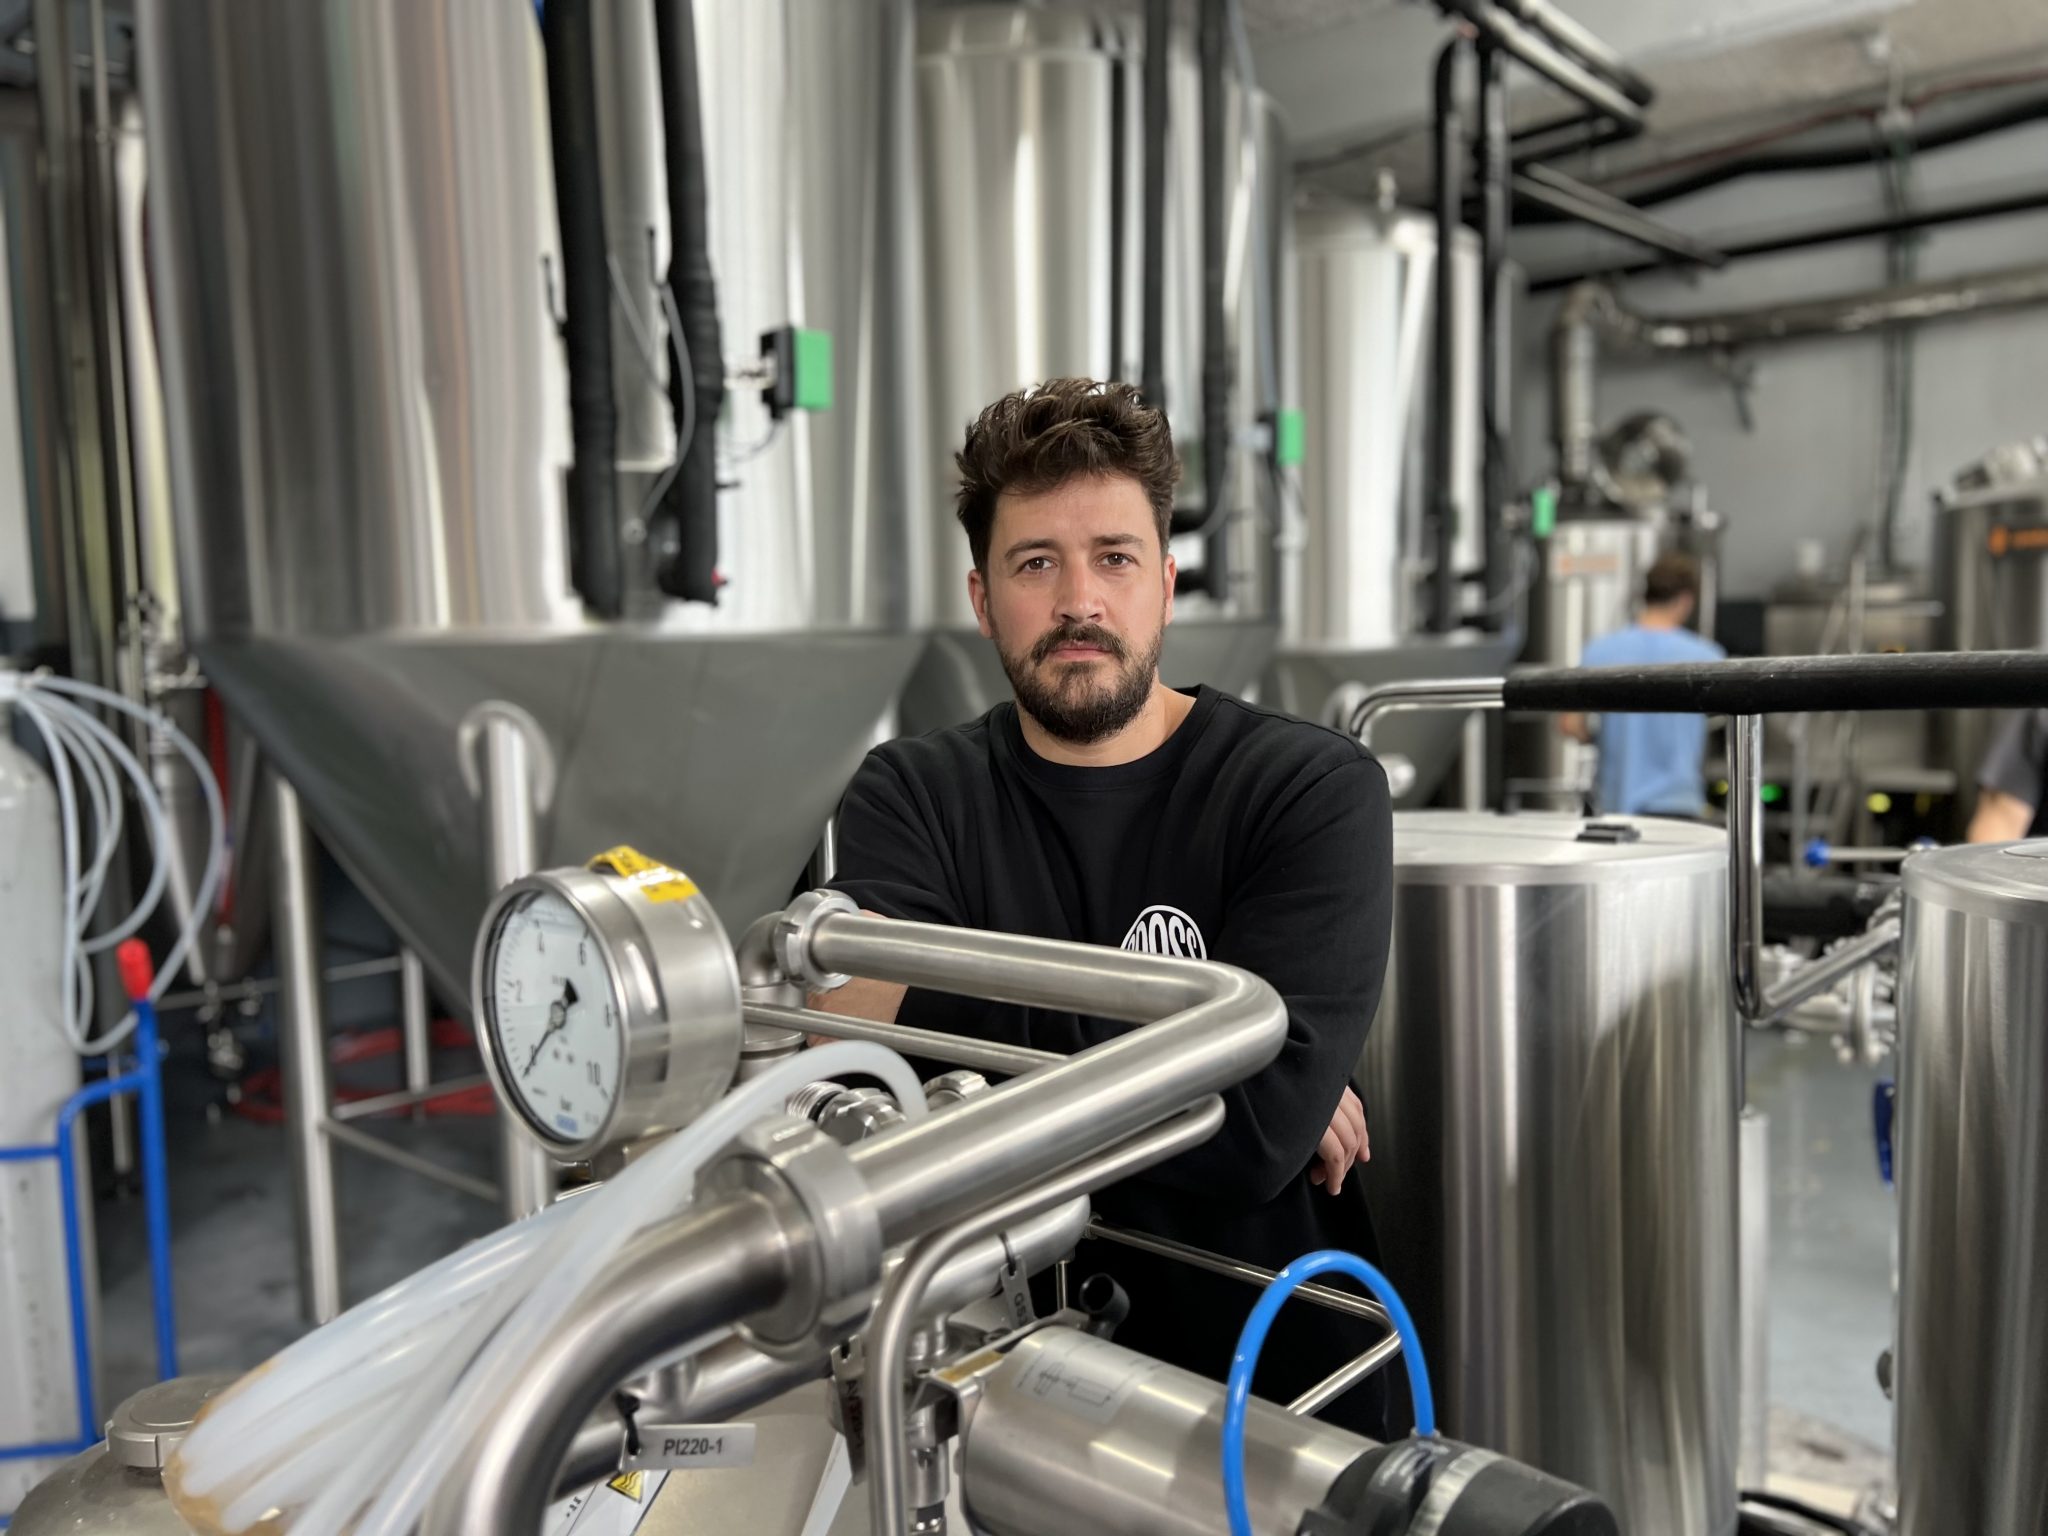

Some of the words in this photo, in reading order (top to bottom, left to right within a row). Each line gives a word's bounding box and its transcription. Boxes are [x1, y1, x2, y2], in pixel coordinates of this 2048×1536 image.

[515, 979, 523, 1003] 2
[586, 1060, 601, 1087] 10
[663, 1437, 724, 1456] PI220-1
